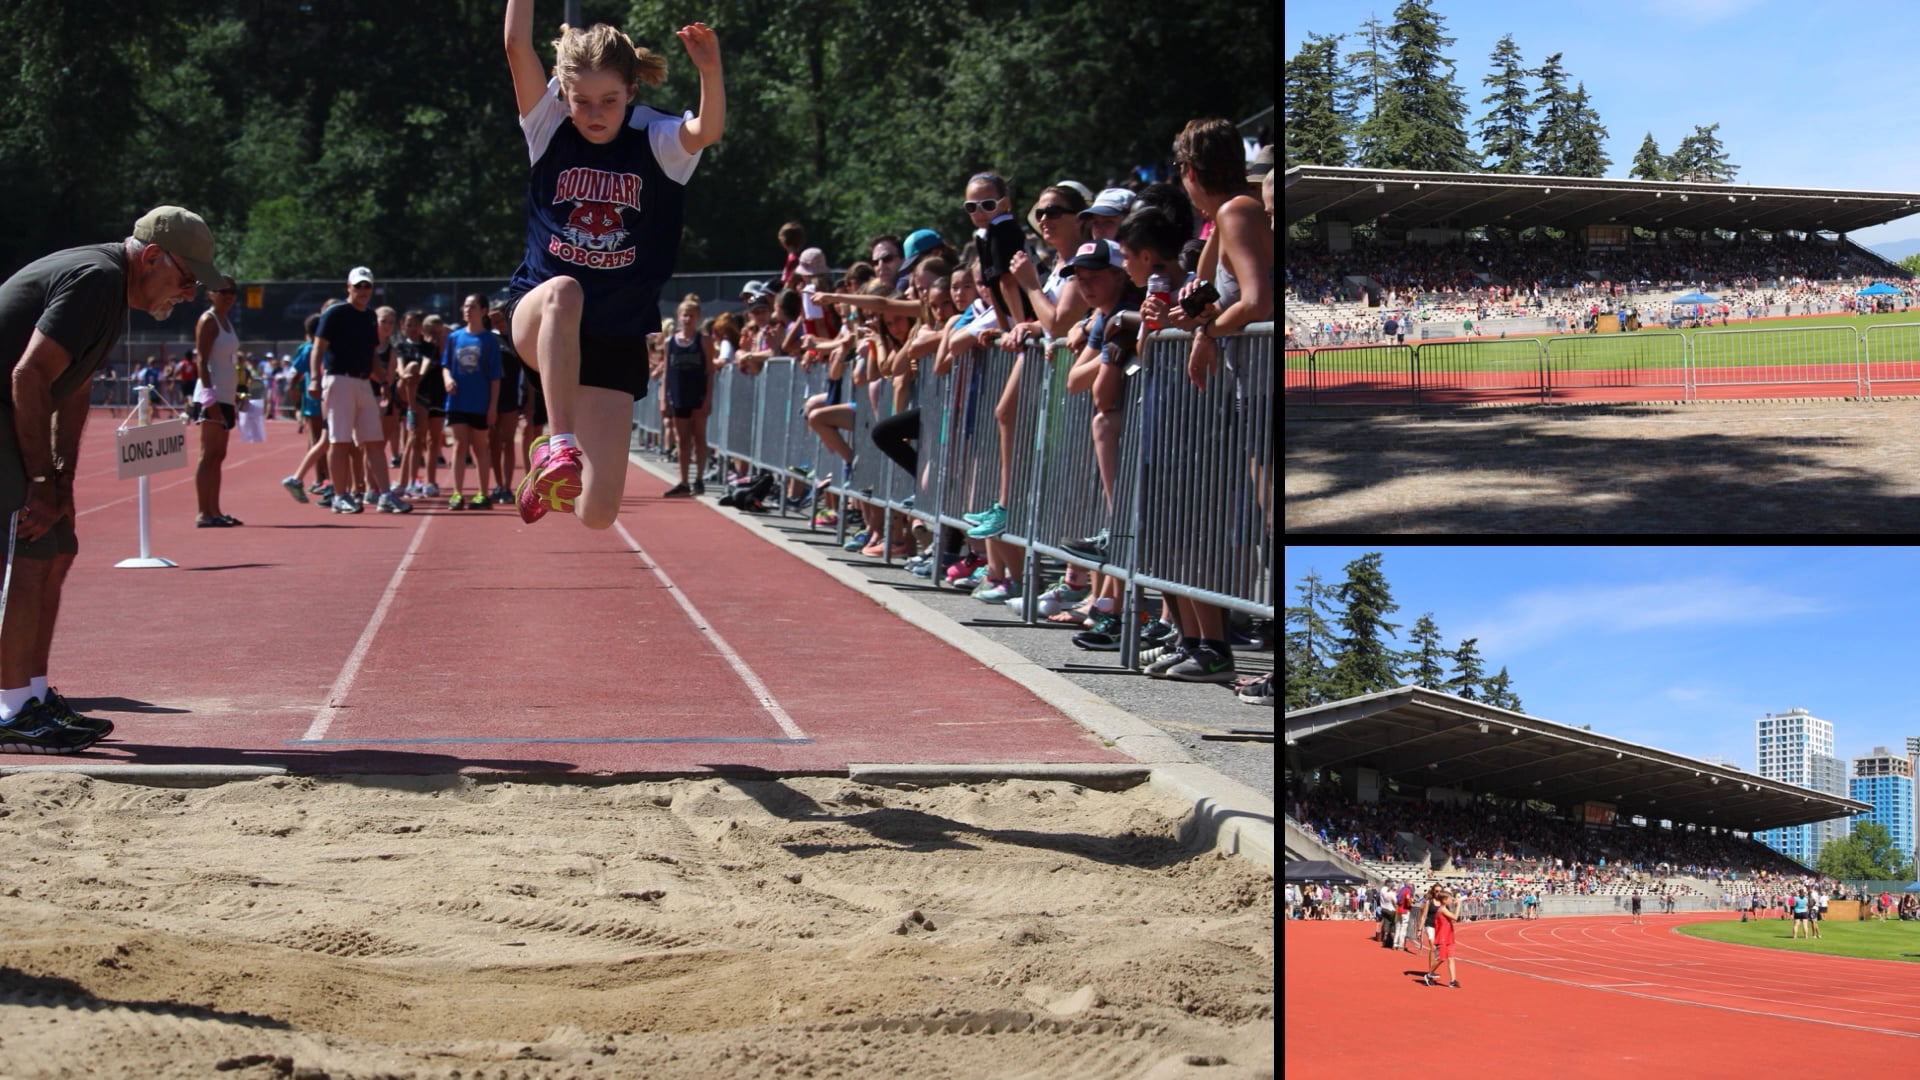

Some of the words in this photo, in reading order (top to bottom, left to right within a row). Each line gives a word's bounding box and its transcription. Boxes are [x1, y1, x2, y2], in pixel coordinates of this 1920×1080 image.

[549, 235, 636, 269] BOBCATS
[122, 441, 153, 463] LONG
[156, 435, 185, 457] JUMP
